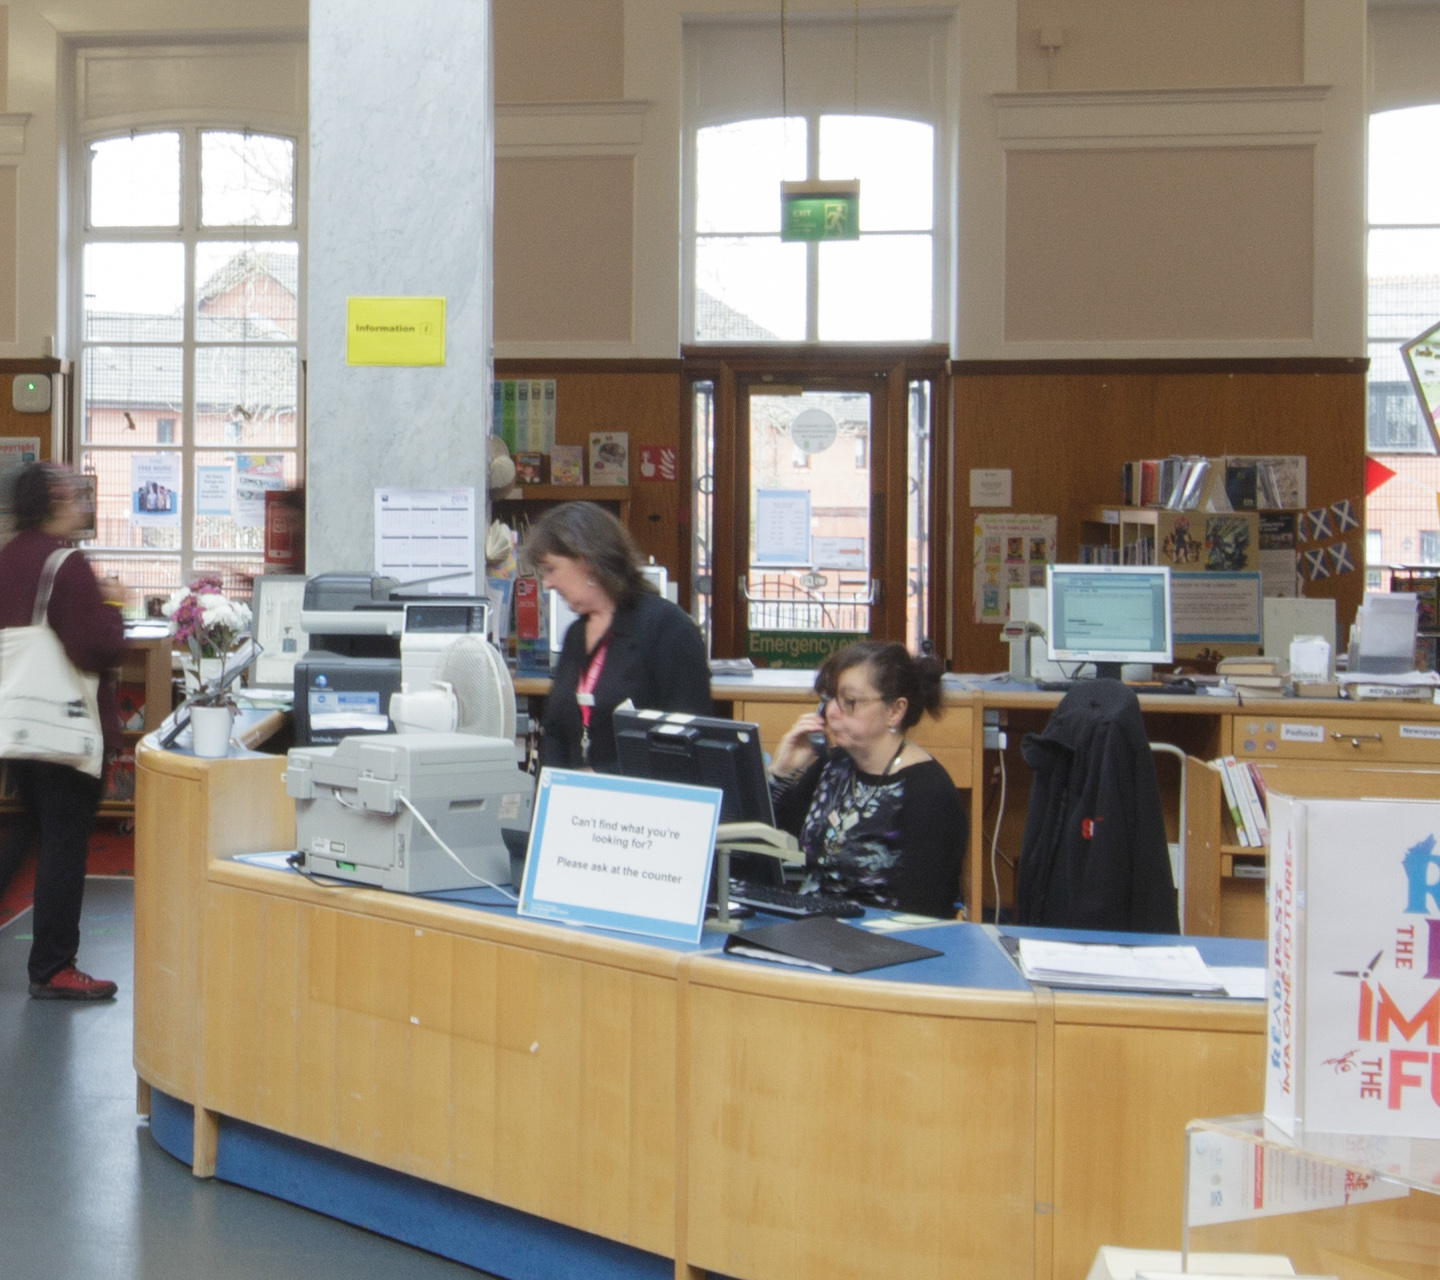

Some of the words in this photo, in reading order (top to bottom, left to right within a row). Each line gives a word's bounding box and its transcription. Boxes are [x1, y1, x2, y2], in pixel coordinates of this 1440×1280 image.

[355, 323, 416, 334] Information
[749, 632, 836, 658] Emergency
[1286, 725, 1319, 738] Padlocks
[571, 816, 597, 828] Can't
[599, 819, 618, 831] find
[620, 823, 645, 835] what
[647, 827, 680, 840] you're
[592, 833, 629, 848] looking
[631, 839, 653, 850] for?
[557, 856, 589, 870] Please
[590, 862, 609, 872] ask
[610, 866, 620, 874] at
[622, 867, 639, 877] the
[641, 869, 682, 884] counter
[1394, 925, 1414, 970] THE
[1360, 1058, 1382, 1101] THE
